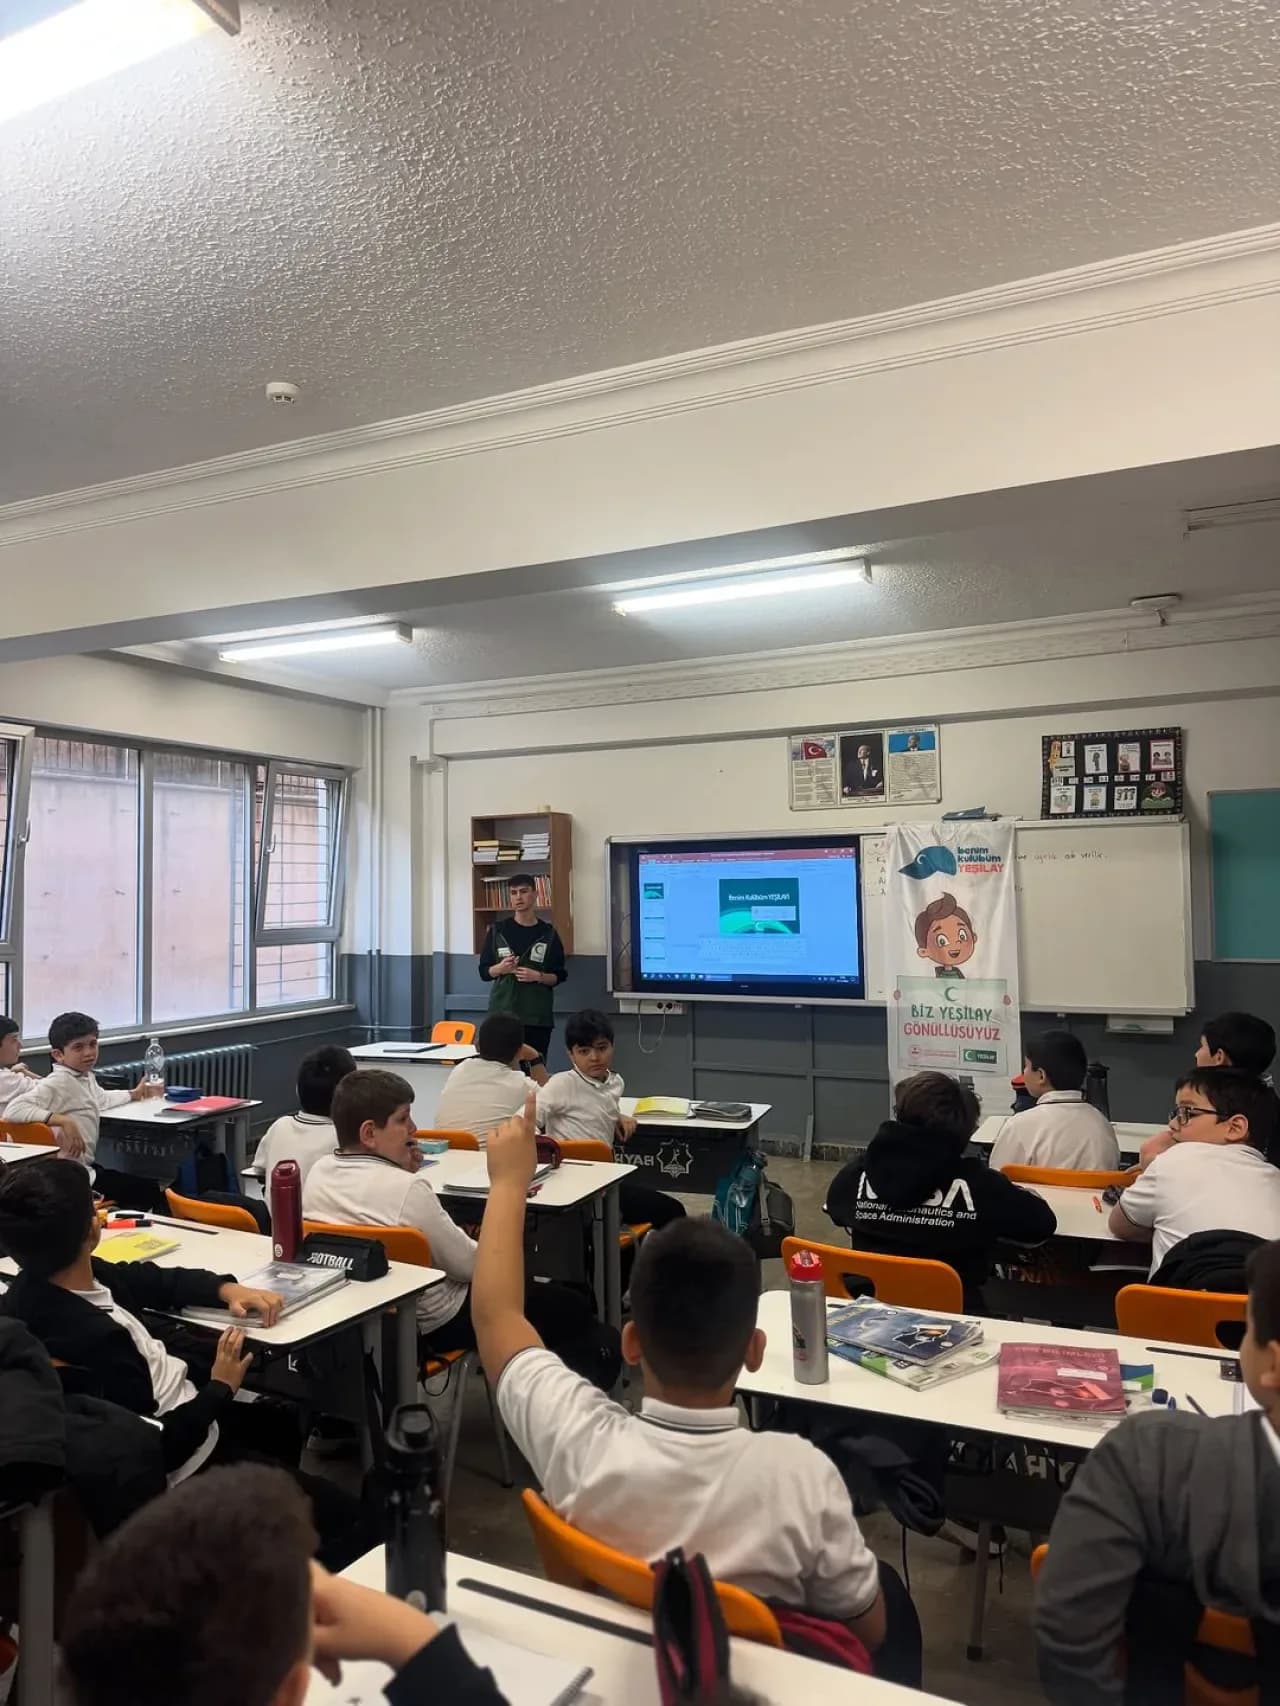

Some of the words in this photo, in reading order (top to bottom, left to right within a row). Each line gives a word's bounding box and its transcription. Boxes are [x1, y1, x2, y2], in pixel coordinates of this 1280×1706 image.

[957, 846, 989, 854] benim
[911, 1003, 935, 1018] BİZ
[940, 1004, 993, 1022] YEŞİLAY
[855, 1210, 878, 1220] Space
[879, 1212, 956, 1228] Administration
[956, 1210, 978, 1220] and
